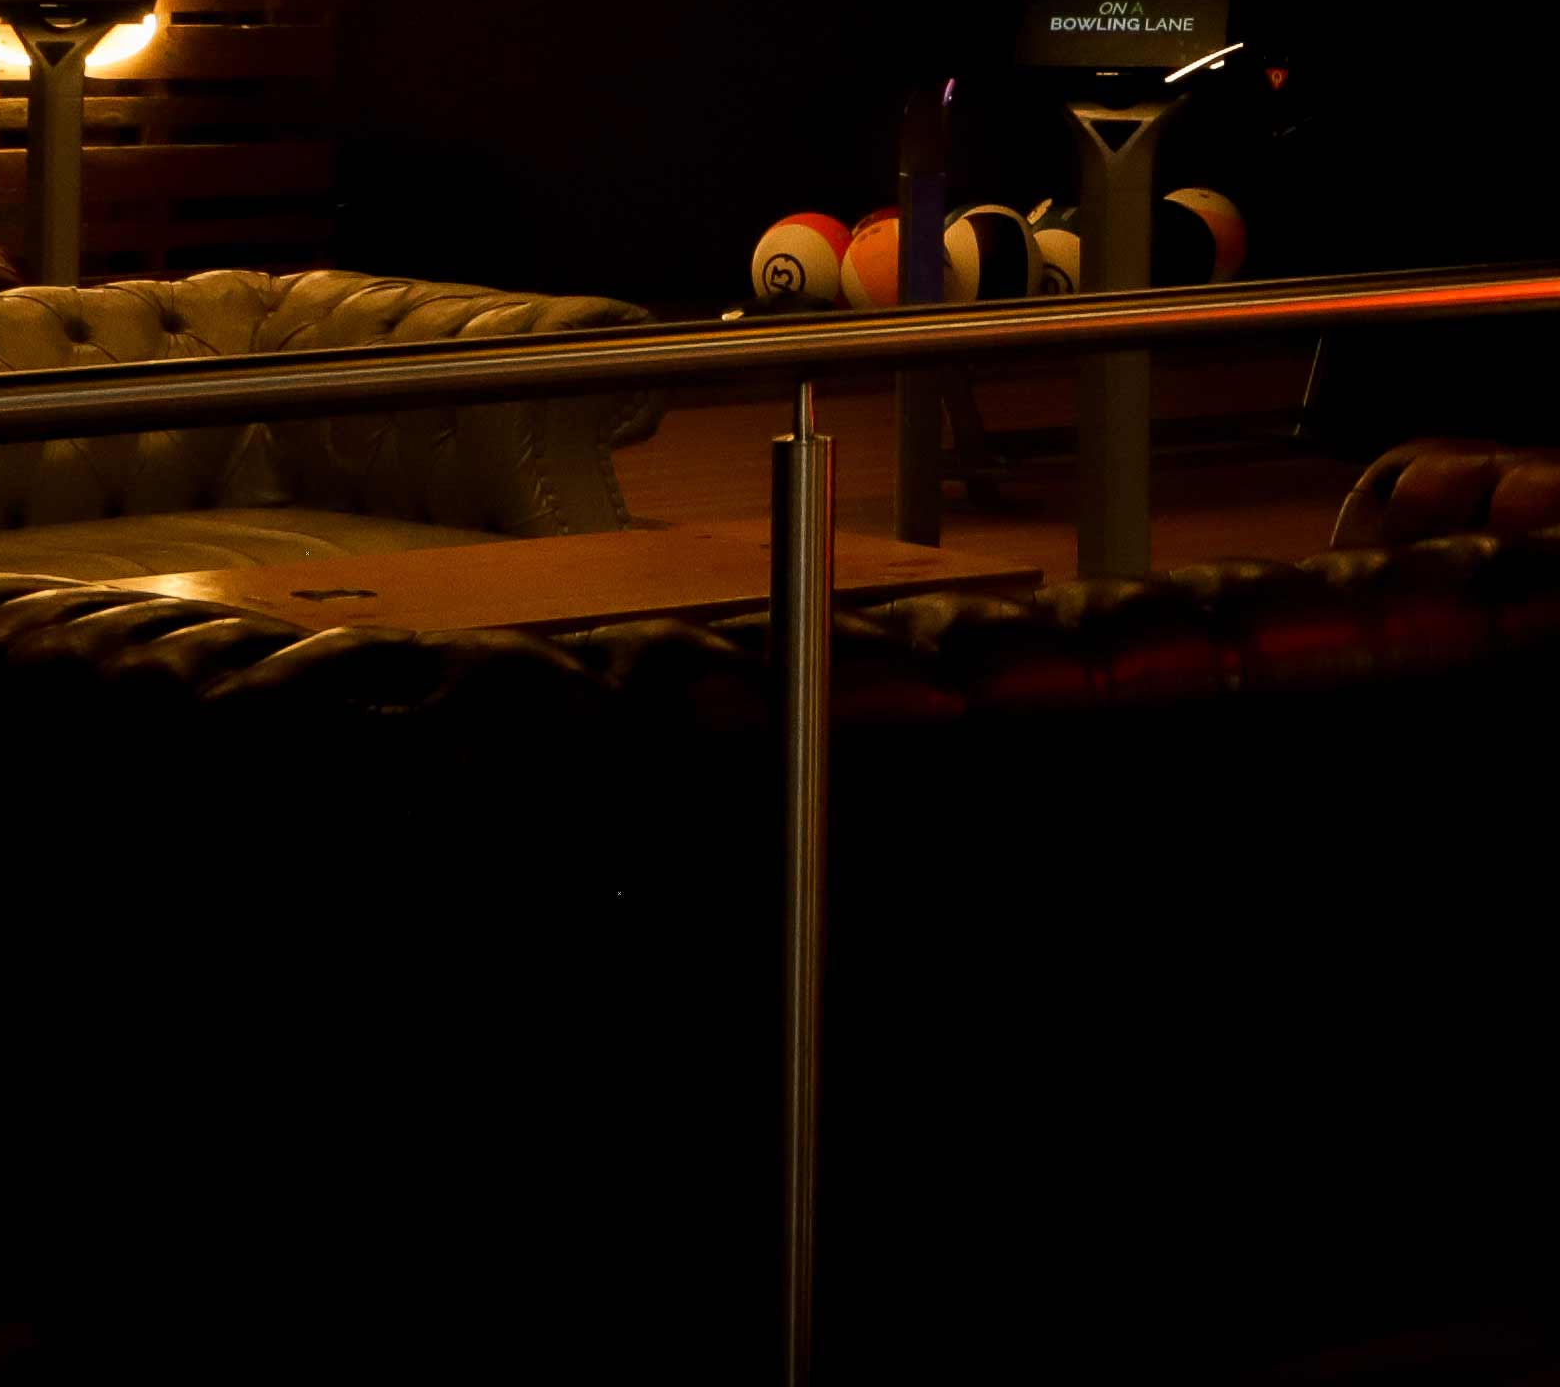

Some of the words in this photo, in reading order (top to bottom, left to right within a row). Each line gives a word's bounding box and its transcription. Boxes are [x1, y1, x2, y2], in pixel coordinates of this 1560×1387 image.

[1099, 1, 1128, 15] ON
[1131, 2, 1144, 15] A
[1050, 17, 1140, 31] BOWLING
[1145, 17, 1195, 31] LANE
